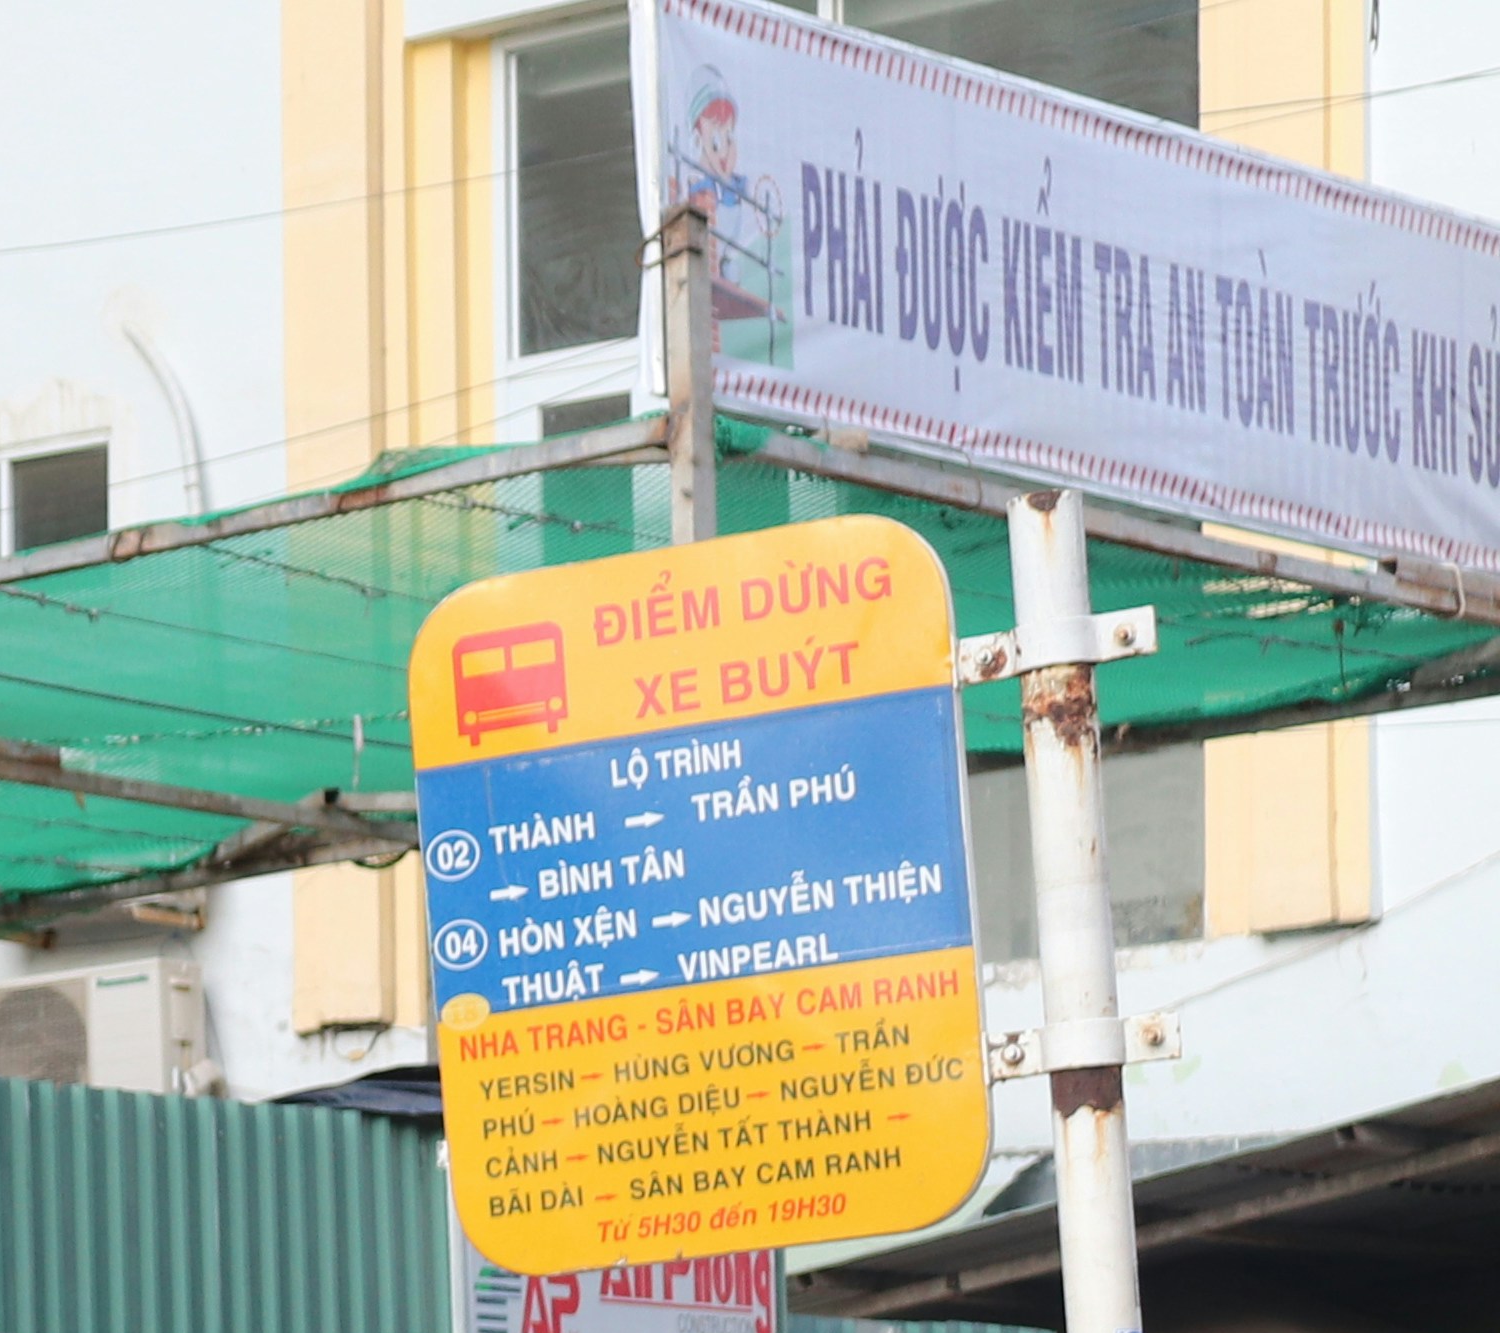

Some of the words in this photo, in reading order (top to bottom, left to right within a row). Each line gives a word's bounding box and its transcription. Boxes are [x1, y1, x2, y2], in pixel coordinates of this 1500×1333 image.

[801, 127, 884, 334] PHẢI
[896, 175, 989, 392] ĐƯỢC
[1002, 157, 1084, 384] KIỂM
[1095, 241, 1156, 401] TRA
[1167, 262, 1206, 414] AN
[1216, 248, 1294, 436] TOÀN
[1304, 280, 1399, 463] TRƯỚC
[1412, 328, 1457, 476] KHI
[594, 572, 720, 648] ĐIỂM
[741, 556, 893, 623] DỪNG
[634, 672, 700, 719] XE
[720, 641, 860, 705] BUÝT
[611, 754, 649, 791] LỘ
[655, 739, 742, 781] TRÌNH
[437, 842, 470, 871] 02
[489, 811, 595, 855] THÀNH
[789, 763, 857, 808] PHÚ
[444, 930, 478, 960] 04
[499, 918, 565, 958] HÒN
[573, 908, 637, 949] XỆN
[699, 870, 834, 928] NGUYỄN
[843, 859, 943, 906] THIỆN
[538, 859, 612, 900] BÌNH
[621, 848, 685, 889] TÂN
[502, 961, 604, 1006] THUẬT
[677, 934, 839, 984] VINPEARL
[459, 1030, 519, 1063] NHA
[527, 1016, 628, 1053] TRANG
[655, 1000, 715, 1035] SÂN
[727, 993, 786, 1026] BAY
[797, 983, 863, 1018] CAM
[874, 970, 960, 1005] RANH
[480, 1069, 576, 1101] YERSIN
[614, 1047, 691, 1083] HÙNG
[701, 1038, 796, 1071] VƯƠNG
[483, 1106, 536, 1140] PHÚ
[574, 1093, 669, 1130] HOÀNG
[678, 1087, 741, 1120] DIỆU
[780, 1060, 896, 1102] NGUYỄN
[906, 1056, 965, 1086] ĐỨC
[486, 1147, 559, 1179] CẢNH
[597, 1122, 709, 1165] NGUYỄN
[719, 1116, 767, 1150] TẤT
[778, 1107, 873, 1141] THÀNH
[489, 1189, 533, 1218] BÃI
[540, 1184, 584, 1212] DÀI
[629, 1166, 683, 1201] SÂN
[693, 1165, 747, 1193] BAY
[757, 1155, 815, 1185] CAM
[825, 1146, 903, 1176] RANH
[598, 1217, 630, 1243] Từ
[638, 1209, 701, 1238] 5H30
[708, 1202, 758, 1230] đến
[767, 1192, 848, 1223] 19H30
